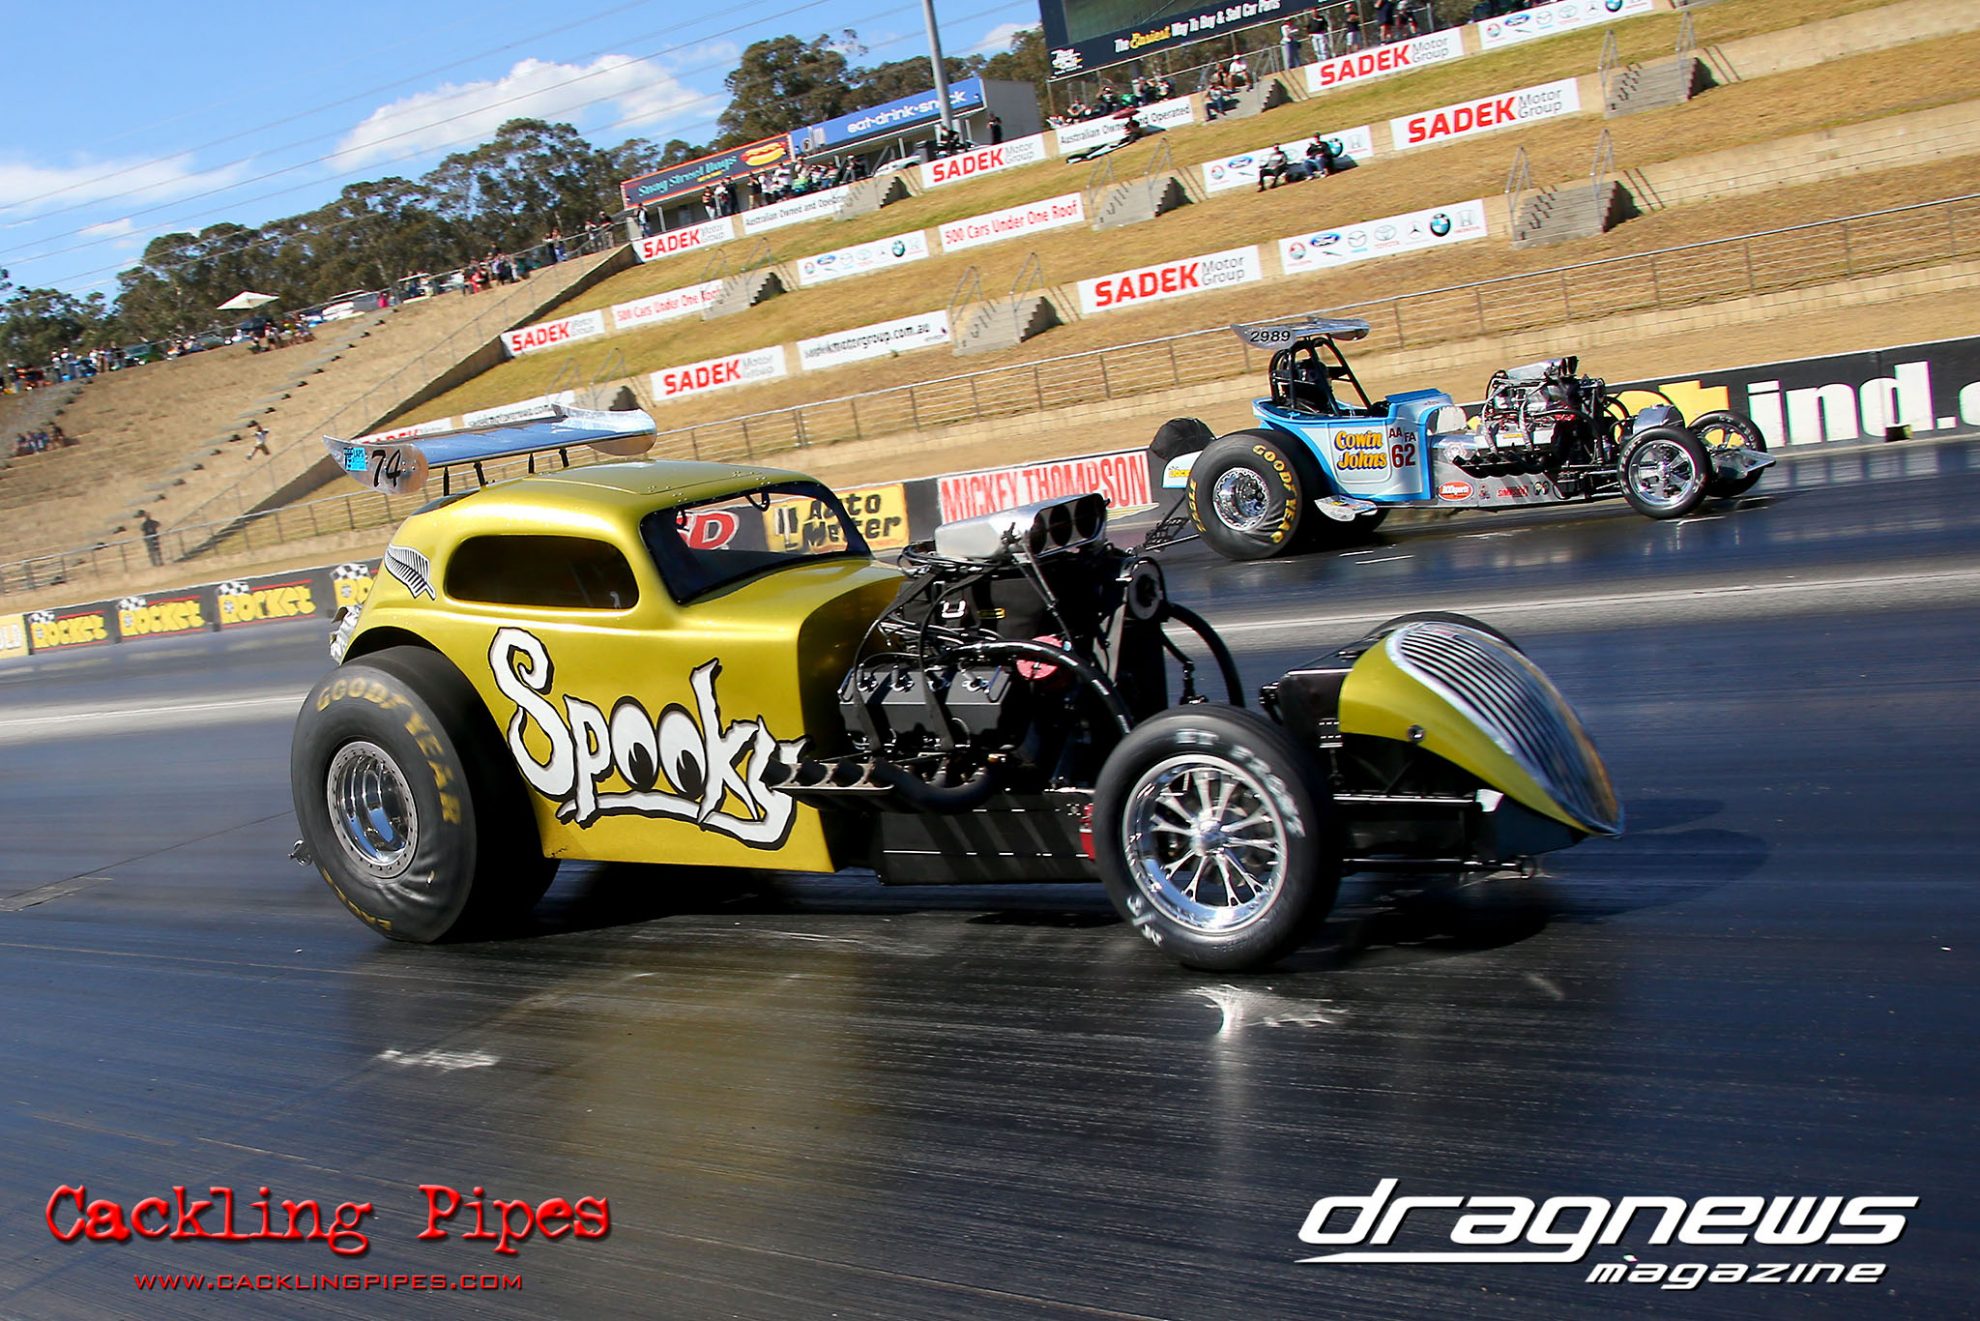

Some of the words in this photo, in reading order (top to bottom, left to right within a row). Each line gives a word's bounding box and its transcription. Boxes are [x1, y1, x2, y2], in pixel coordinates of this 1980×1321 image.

[1242, 2, 1258, 17] Car
[1320, 44, 1412, 87] SADEK
[1412, 36, 1450, 54] Motor
[1413, 46, 1450, 64] Group
[1408, 96, 1517, 144] SADEK
[1517, 87, 1563, 107] Motor
[1518, 100, 1563, 118] Group
[932, 147, 1004, 183] SADEK
[967, 224, 990, 239] Cars
[991, 215, 1025, 233] Under
[1027, 210, 1049, 225] One
[1051, 200, 1078, 219] Roof
[643, 229, 701, 259] SADEK
[1095, 262, 1200, 307] SADEK
[1201, 255, 1245, 274] Motor
[1202, 266, 1246, 287] Group
[511, 321, 572, 352] SADEK
[1250, 329, 1292, 343] 2989
[663, 358, 741, 395] SADEK
[1334, 430, 1384, 451] Cowin
[1388, 427, 1403, 439] AA
[1404, 431, 1417, 442] FA
[371, 449, 401, 488] 74
[1336, 450, 1388, 471] Johns
[1391, 443, 1417, 469] 62
[939, 470, 1018, 524] MICKEY
[1021, 453, 1148, 509] THOMPSON
[1252, 444, 1298, 544] GOODYEAR
[487, 627, 813, 851] Spooky
